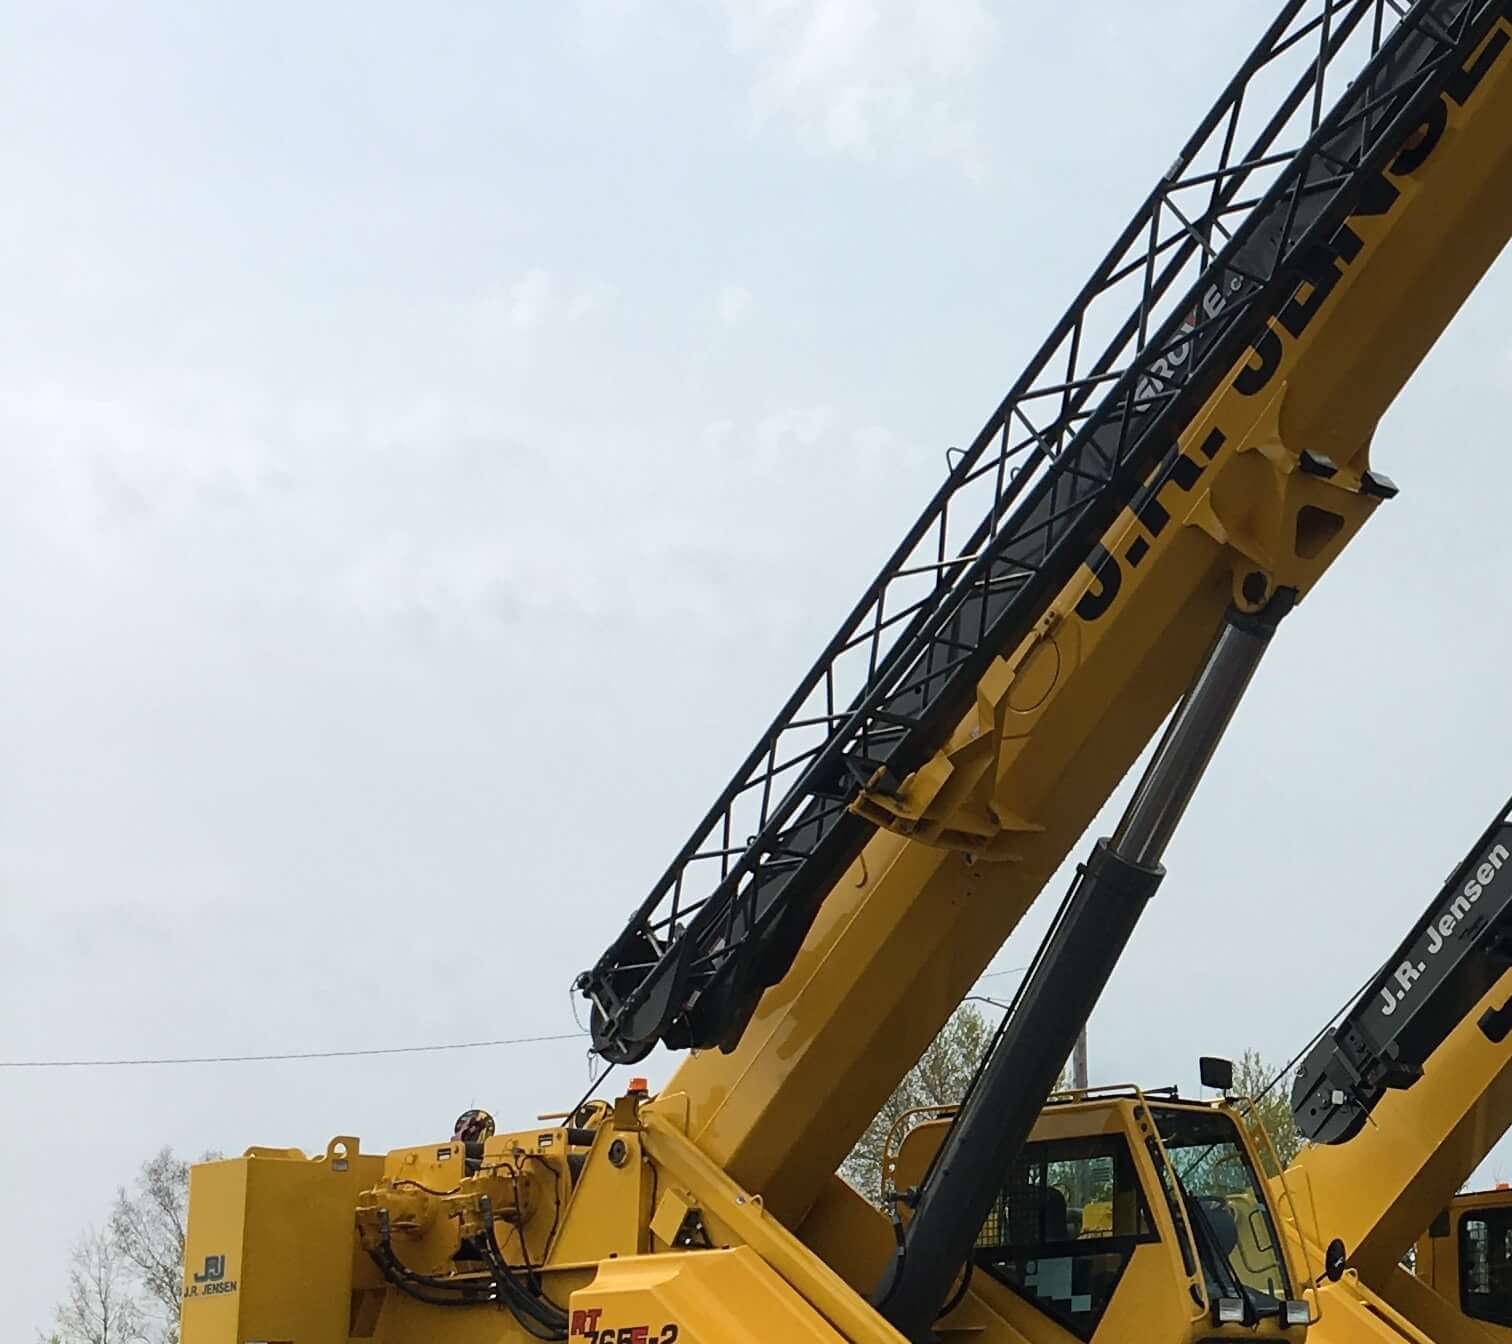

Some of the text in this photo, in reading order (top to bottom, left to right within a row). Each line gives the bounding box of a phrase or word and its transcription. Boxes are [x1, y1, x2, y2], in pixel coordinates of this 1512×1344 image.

[1380, 844, 1510, 1015] J.R. Jensen
[184, 1280, 237, 1297] J.R. JENSEN
[571, 1309, 602, 1336] RT
